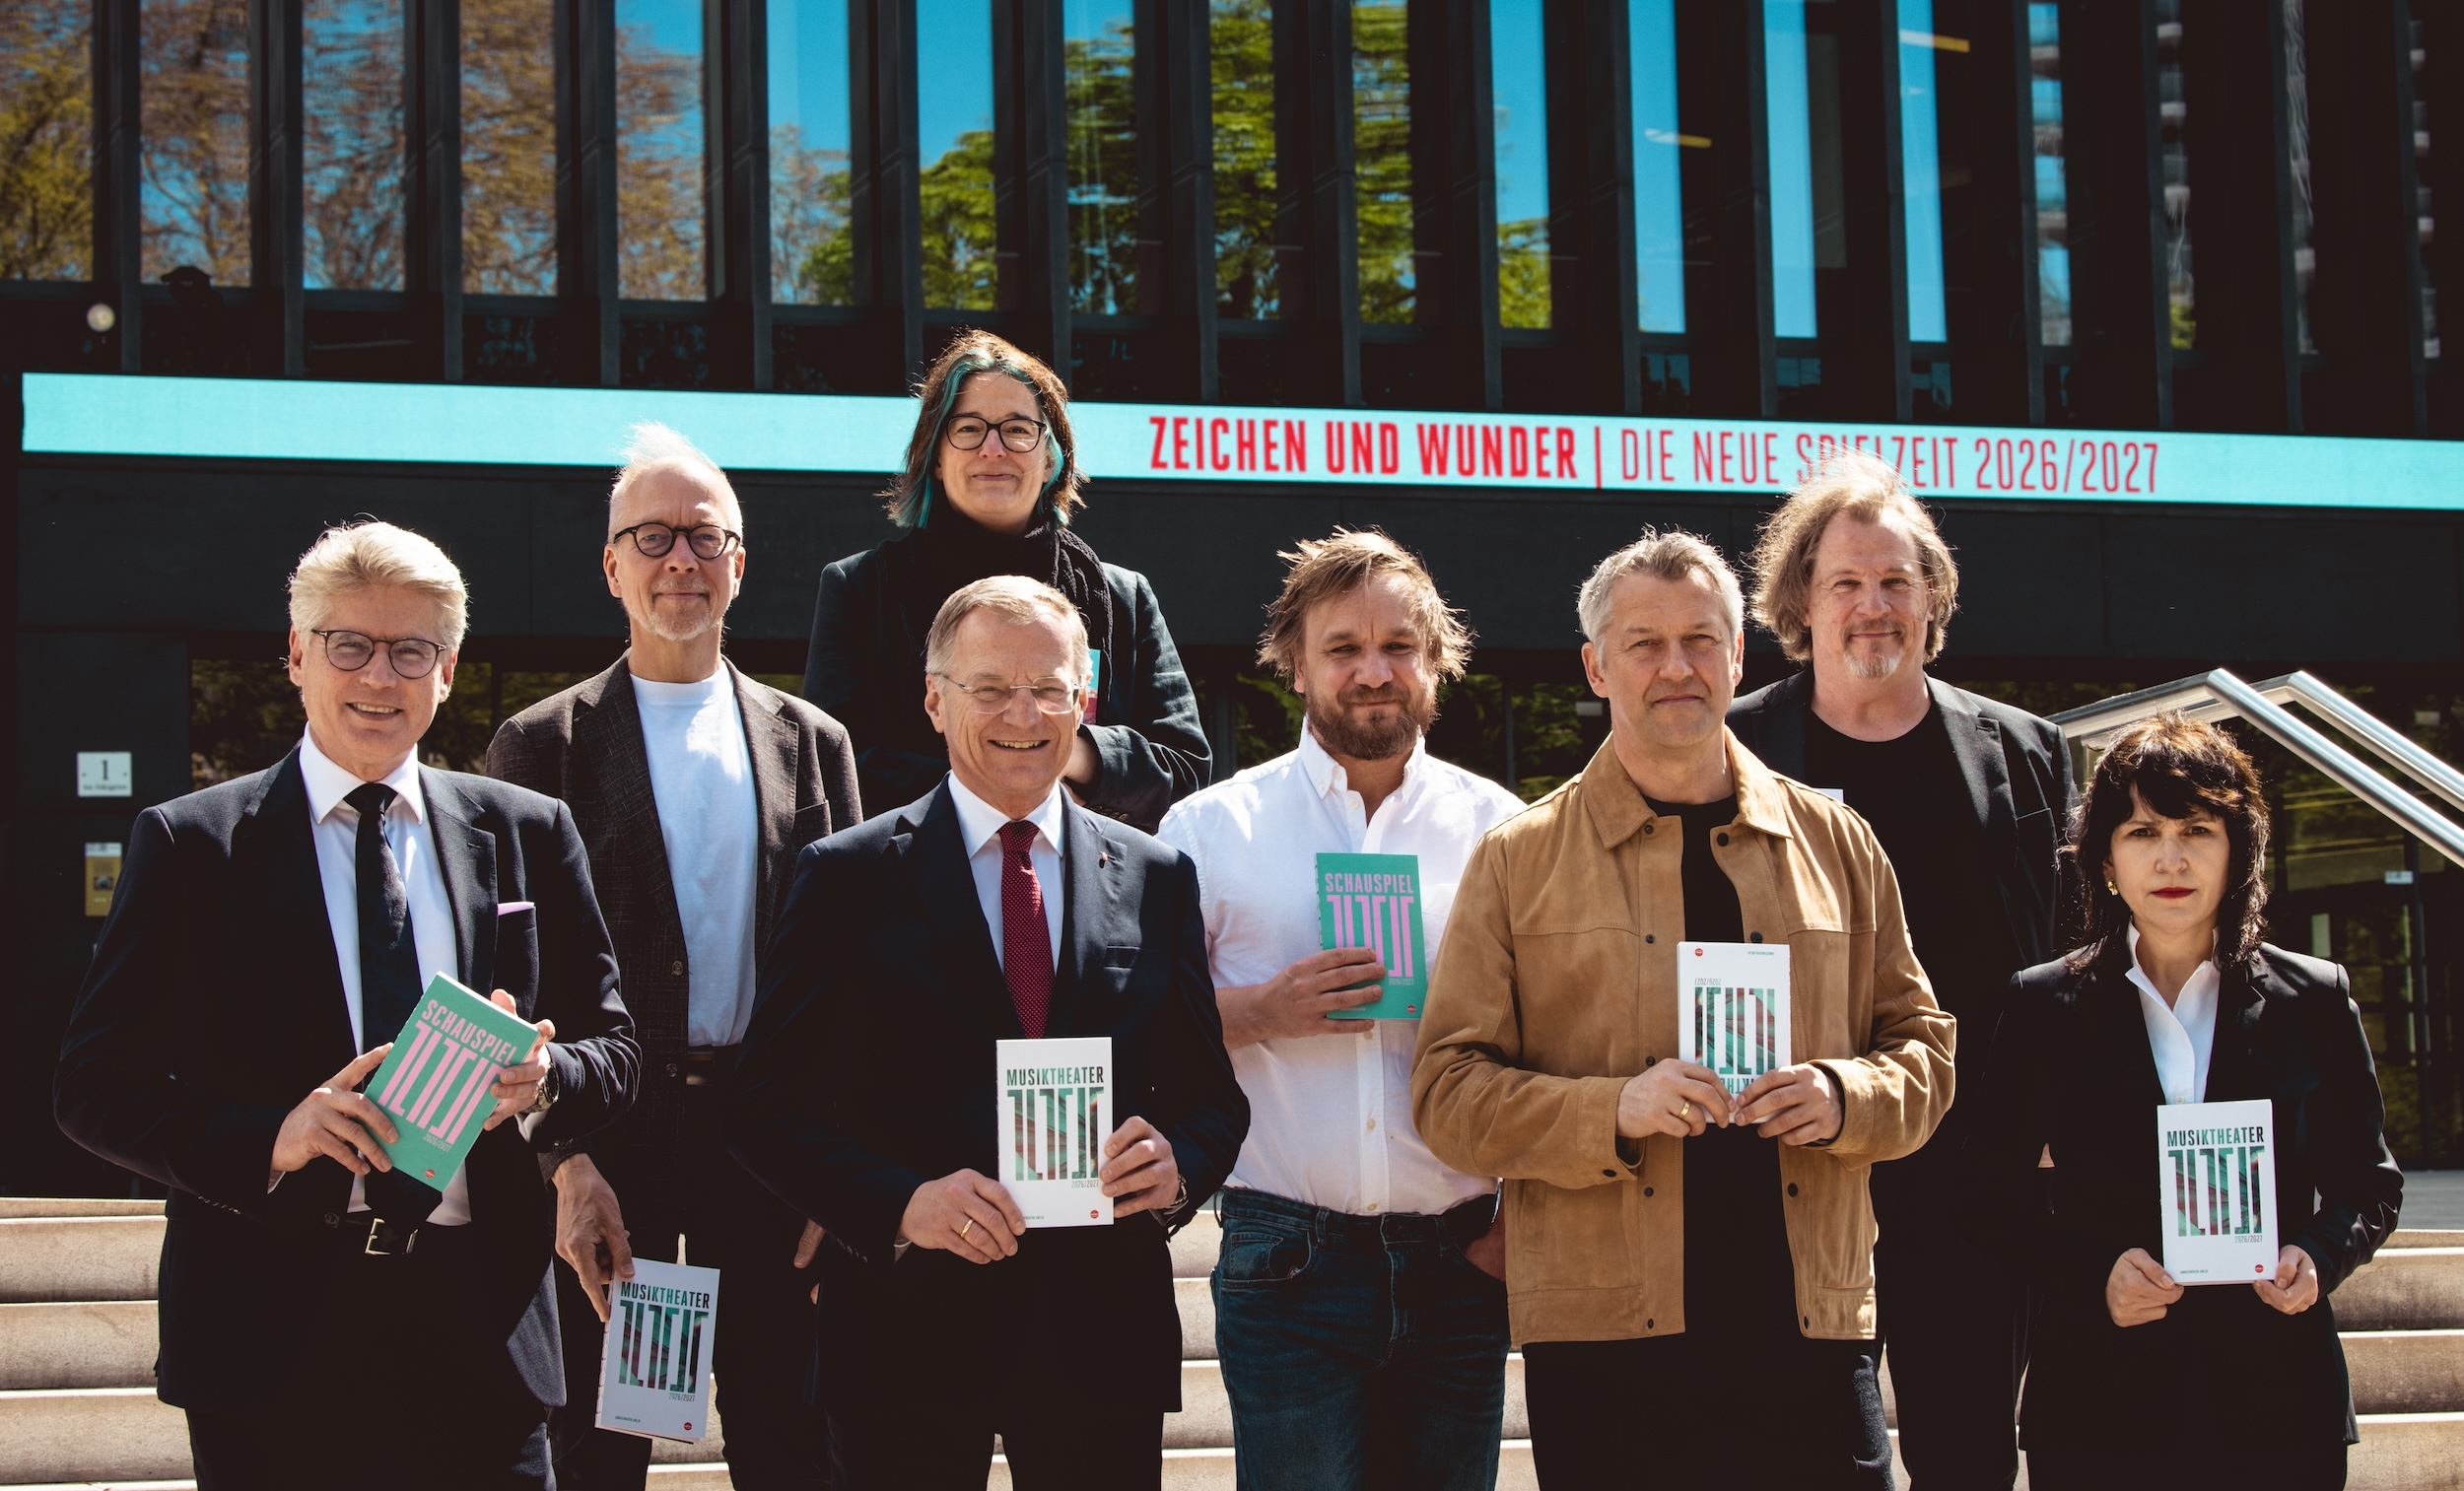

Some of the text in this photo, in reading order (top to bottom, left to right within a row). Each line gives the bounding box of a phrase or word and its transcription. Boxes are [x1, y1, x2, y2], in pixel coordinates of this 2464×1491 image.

[1149, 416, 1307, 472] ZEICHEN
[1326, 421, 1400, 475] UND
[1417, 423, 1578, 479] WUNDER
[1621, 429, 1675, 481] DIE
[1693, 431, 1779, 484] NEUE
[1975, 438, 2158, 493] 2026/2027
[101, 760, 108, 780] 1
[1325, 873, 1414, 894] SCHAUSPIEL
[421, 999, 517, 1066] SCHAUSPIEL
[1006, 1066, 1104, 1086] MUSIKTHEATER
[2167, 1126, 2264, 1147] MUSIKTHEATER
[2234, 1235, 2263, 1244] 2026/2027
[620, 1281, 710, 1310] MUSIKTHEATER
